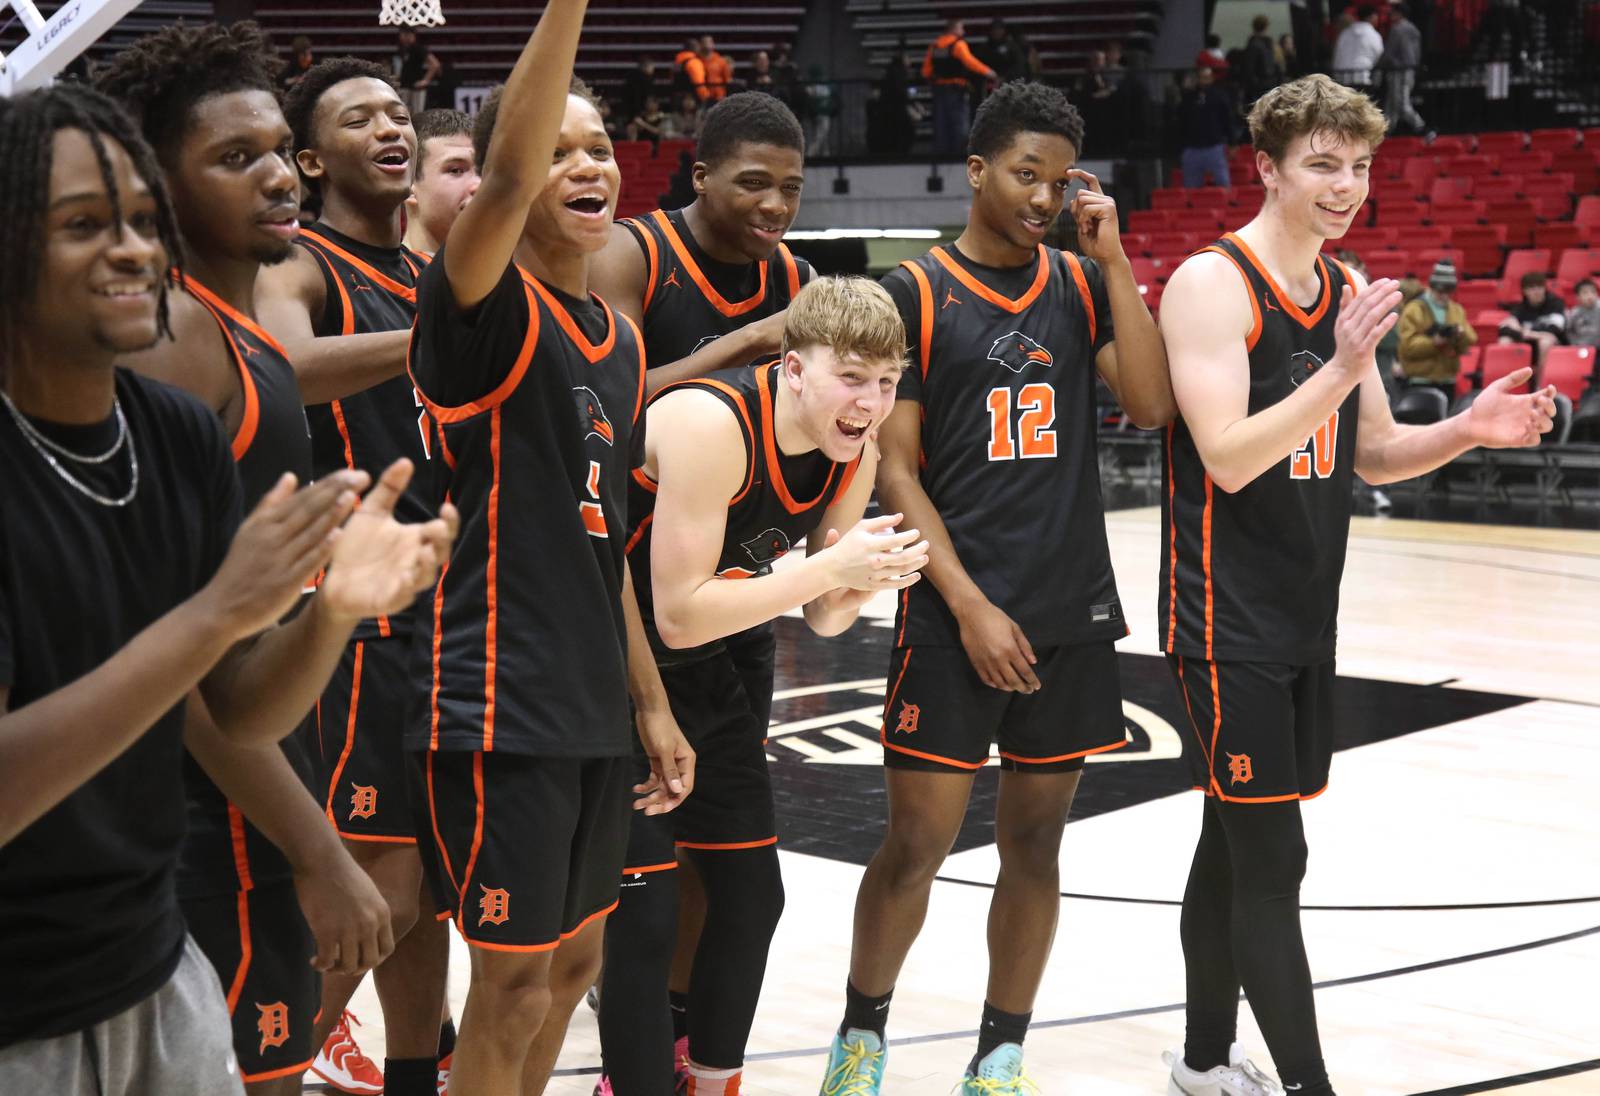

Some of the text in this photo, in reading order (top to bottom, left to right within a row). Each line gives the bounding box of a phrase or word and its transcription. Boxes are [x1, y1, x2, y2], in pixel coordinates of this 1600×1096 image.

[37, 2, 81, 51] LEGACY
[986, 382, 1058, 461] 12
[349, 782, 378, 821] D
[478, 883, 510, 927] D
[254, 1000, 290, 1056] D
